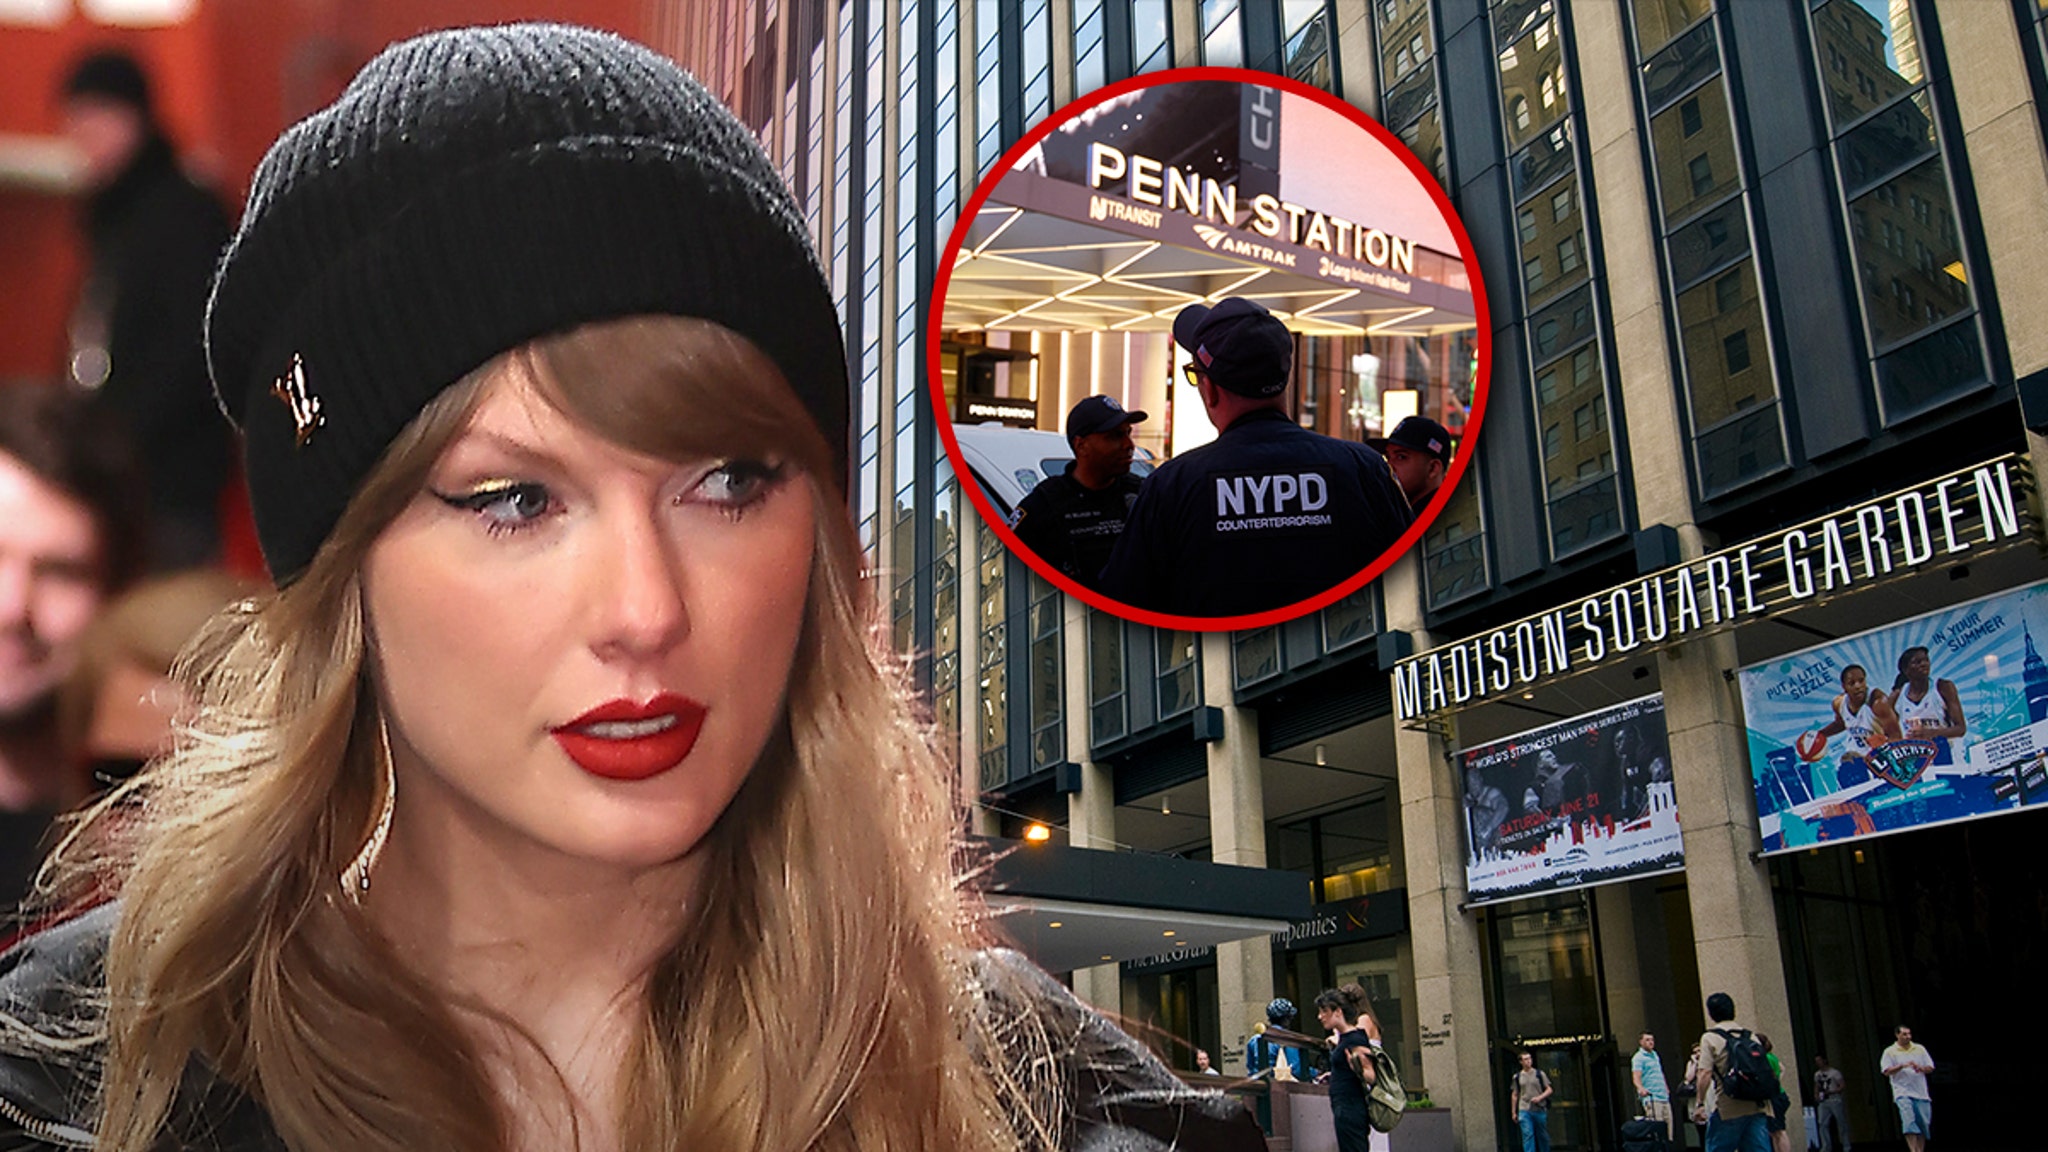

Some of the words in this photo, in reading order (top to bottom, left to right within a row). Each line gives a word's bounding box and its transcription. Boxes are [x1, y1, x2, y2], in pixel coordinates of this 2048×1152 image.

[1087, 141, 1237, 227] PENN
[1252, 194, 1416, 275] STATION
[1106, 200, 1163, 230] TRANSIT
[1222, 237, 1297, 268] AMTRAK
[1216, 472, 1328, 516] NYPD
[1216, 514, 1332, 531] COUNTERTERRORISM
[1393, 609, 1569, 720] MADISON
[1581, 545, 1766, 662] SQUARE
[1782, 461, 2019, 599] GARDEN
[1932, 631, 1946, 646] IN
[1947, 612, 1981, 636] YOUR
[1947, 615, 2006, 653] SUMMER
[1766, 680, 1787, 700] PUT
[1797, 656, 1835, 683] LITTLE
[1790, 670, 1833, 701] SIZZLE
[1510, 733, 1558, 759] STRONGEST
[1559, 728, 1578, 743] MAN
[1499, 808, 1553, 837] SATURDAY
[1558, 797, 1584, 818] JUNE
[1271, 913, 1338, 949] mpanies
